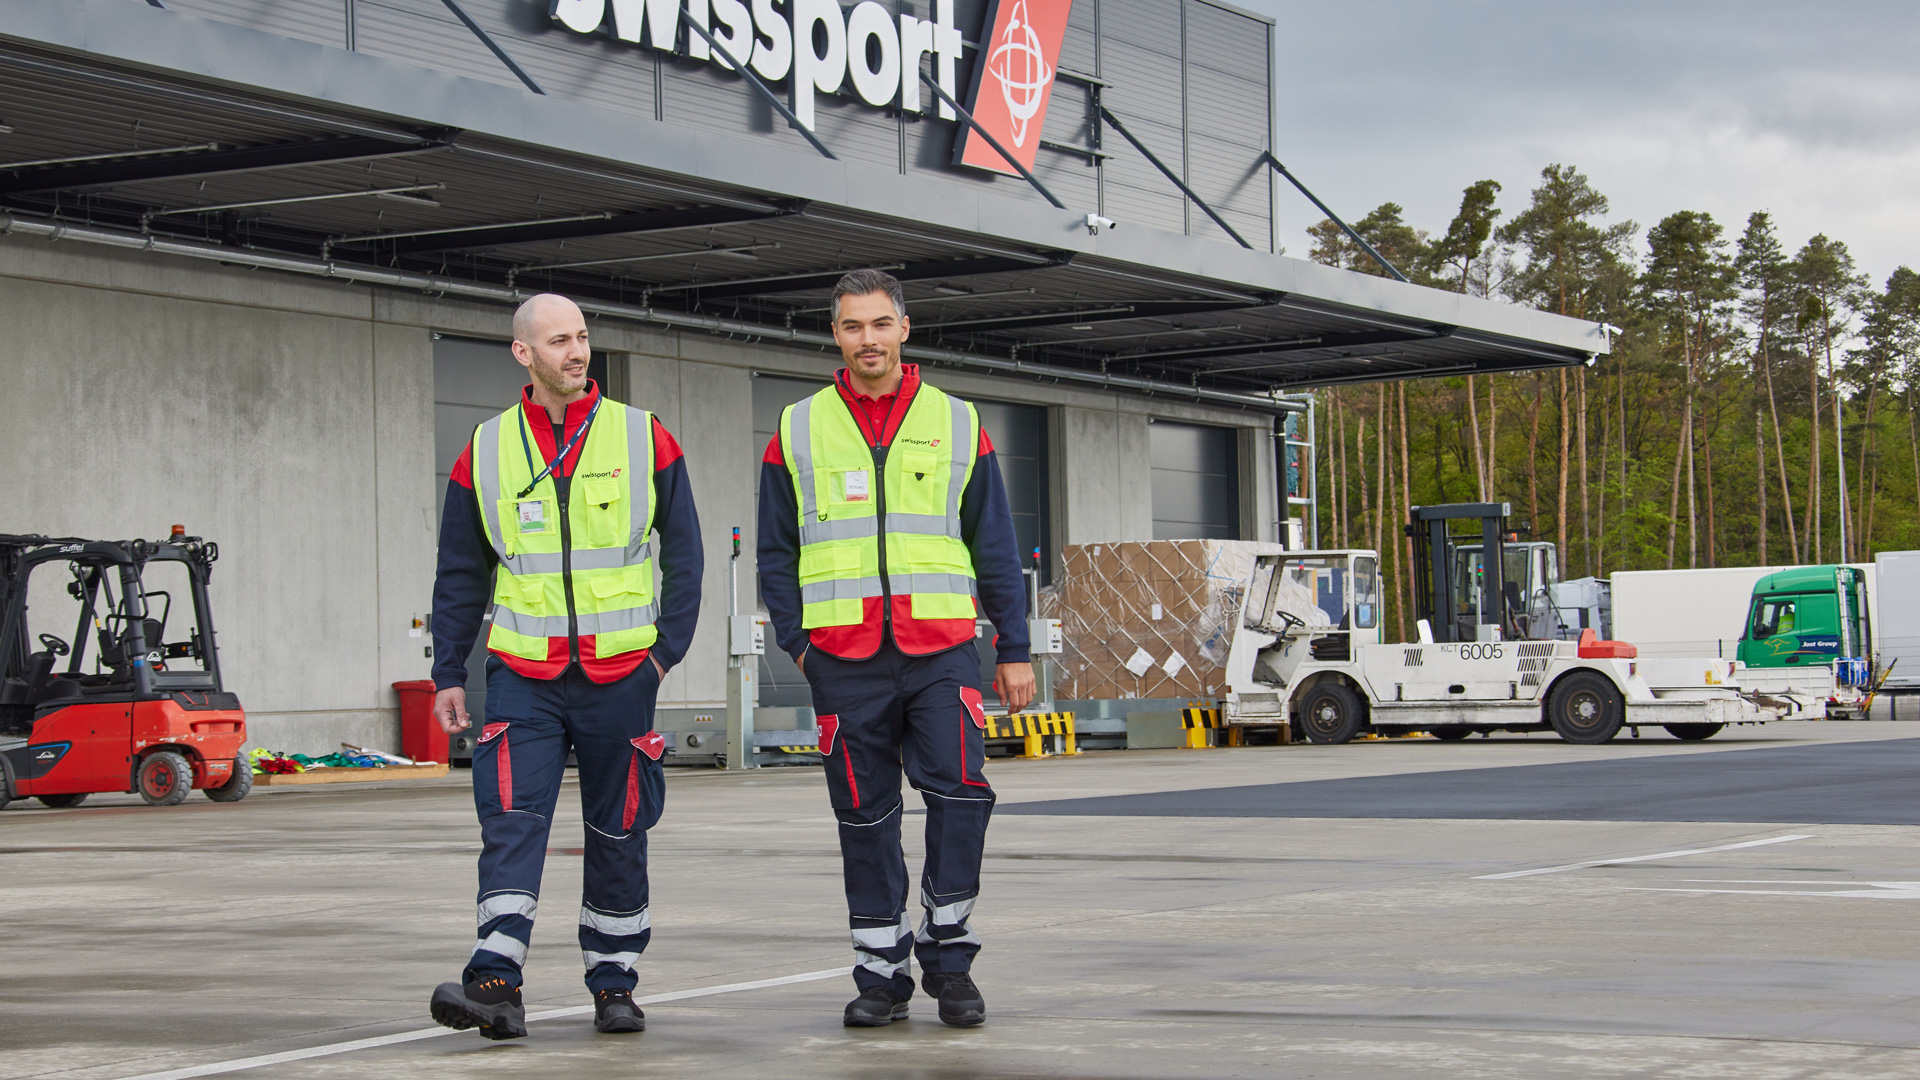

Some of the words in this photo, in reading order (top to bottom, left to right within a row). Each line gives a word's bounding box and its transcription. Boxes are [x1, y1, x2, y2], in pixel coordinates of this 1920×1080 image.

[550, 0, 963, 132] ssport
[581, 471, 611, 479] swissport
[1440, 644, 1458, 653] KCT
[1460, 643, 1503, 660] 6005
